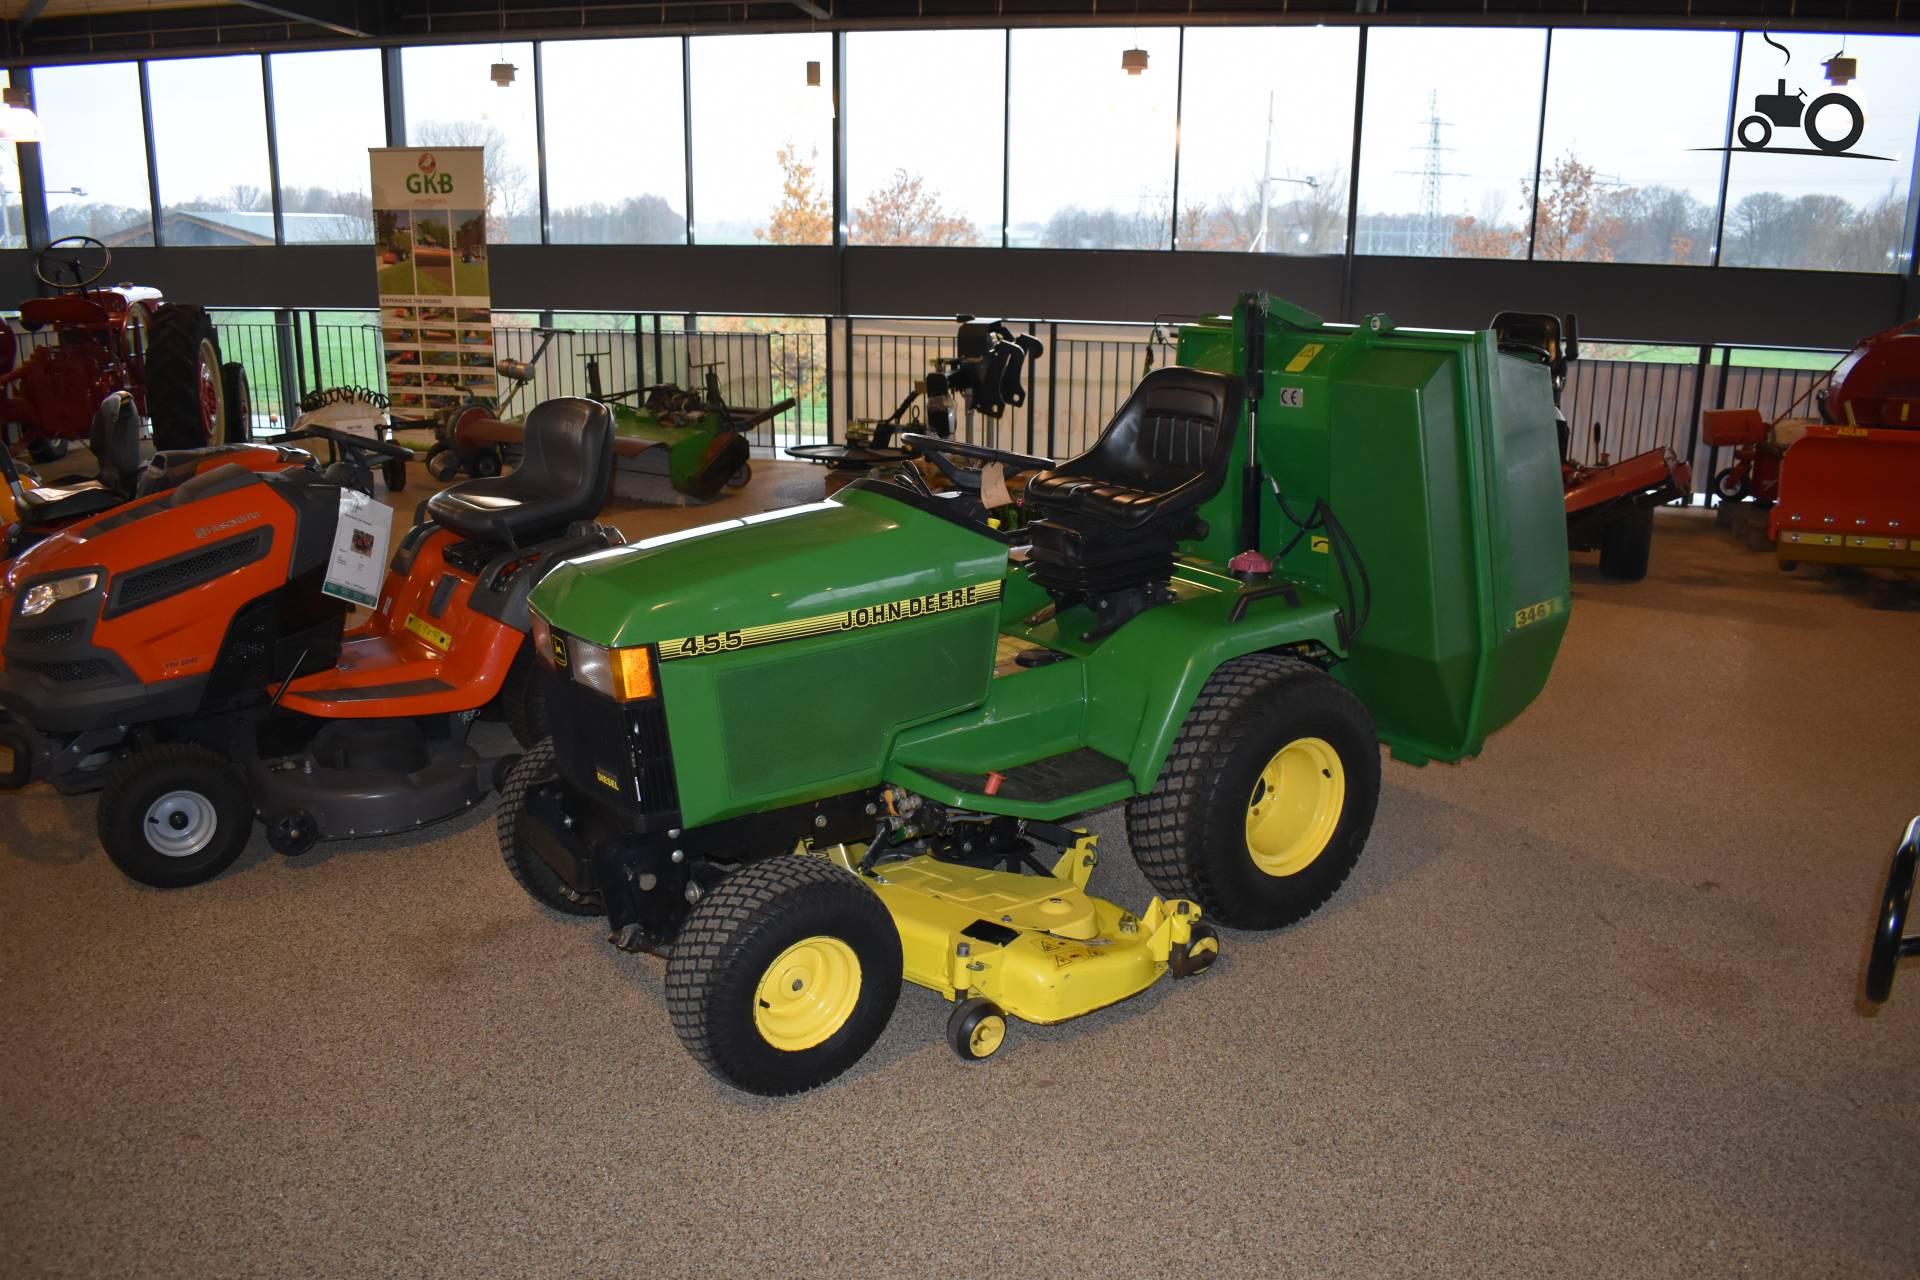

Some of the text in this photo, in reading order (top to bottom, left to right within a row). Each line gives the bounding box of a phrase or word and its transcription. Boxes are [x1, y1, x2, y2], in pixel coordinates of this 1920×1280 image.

[406, 173, 454, 195] GKB
[841, 585, 977, 630] JOHN DEERE
[680, 629, 743, 655] 455
[597, 771, 620, 791] DIESEL
